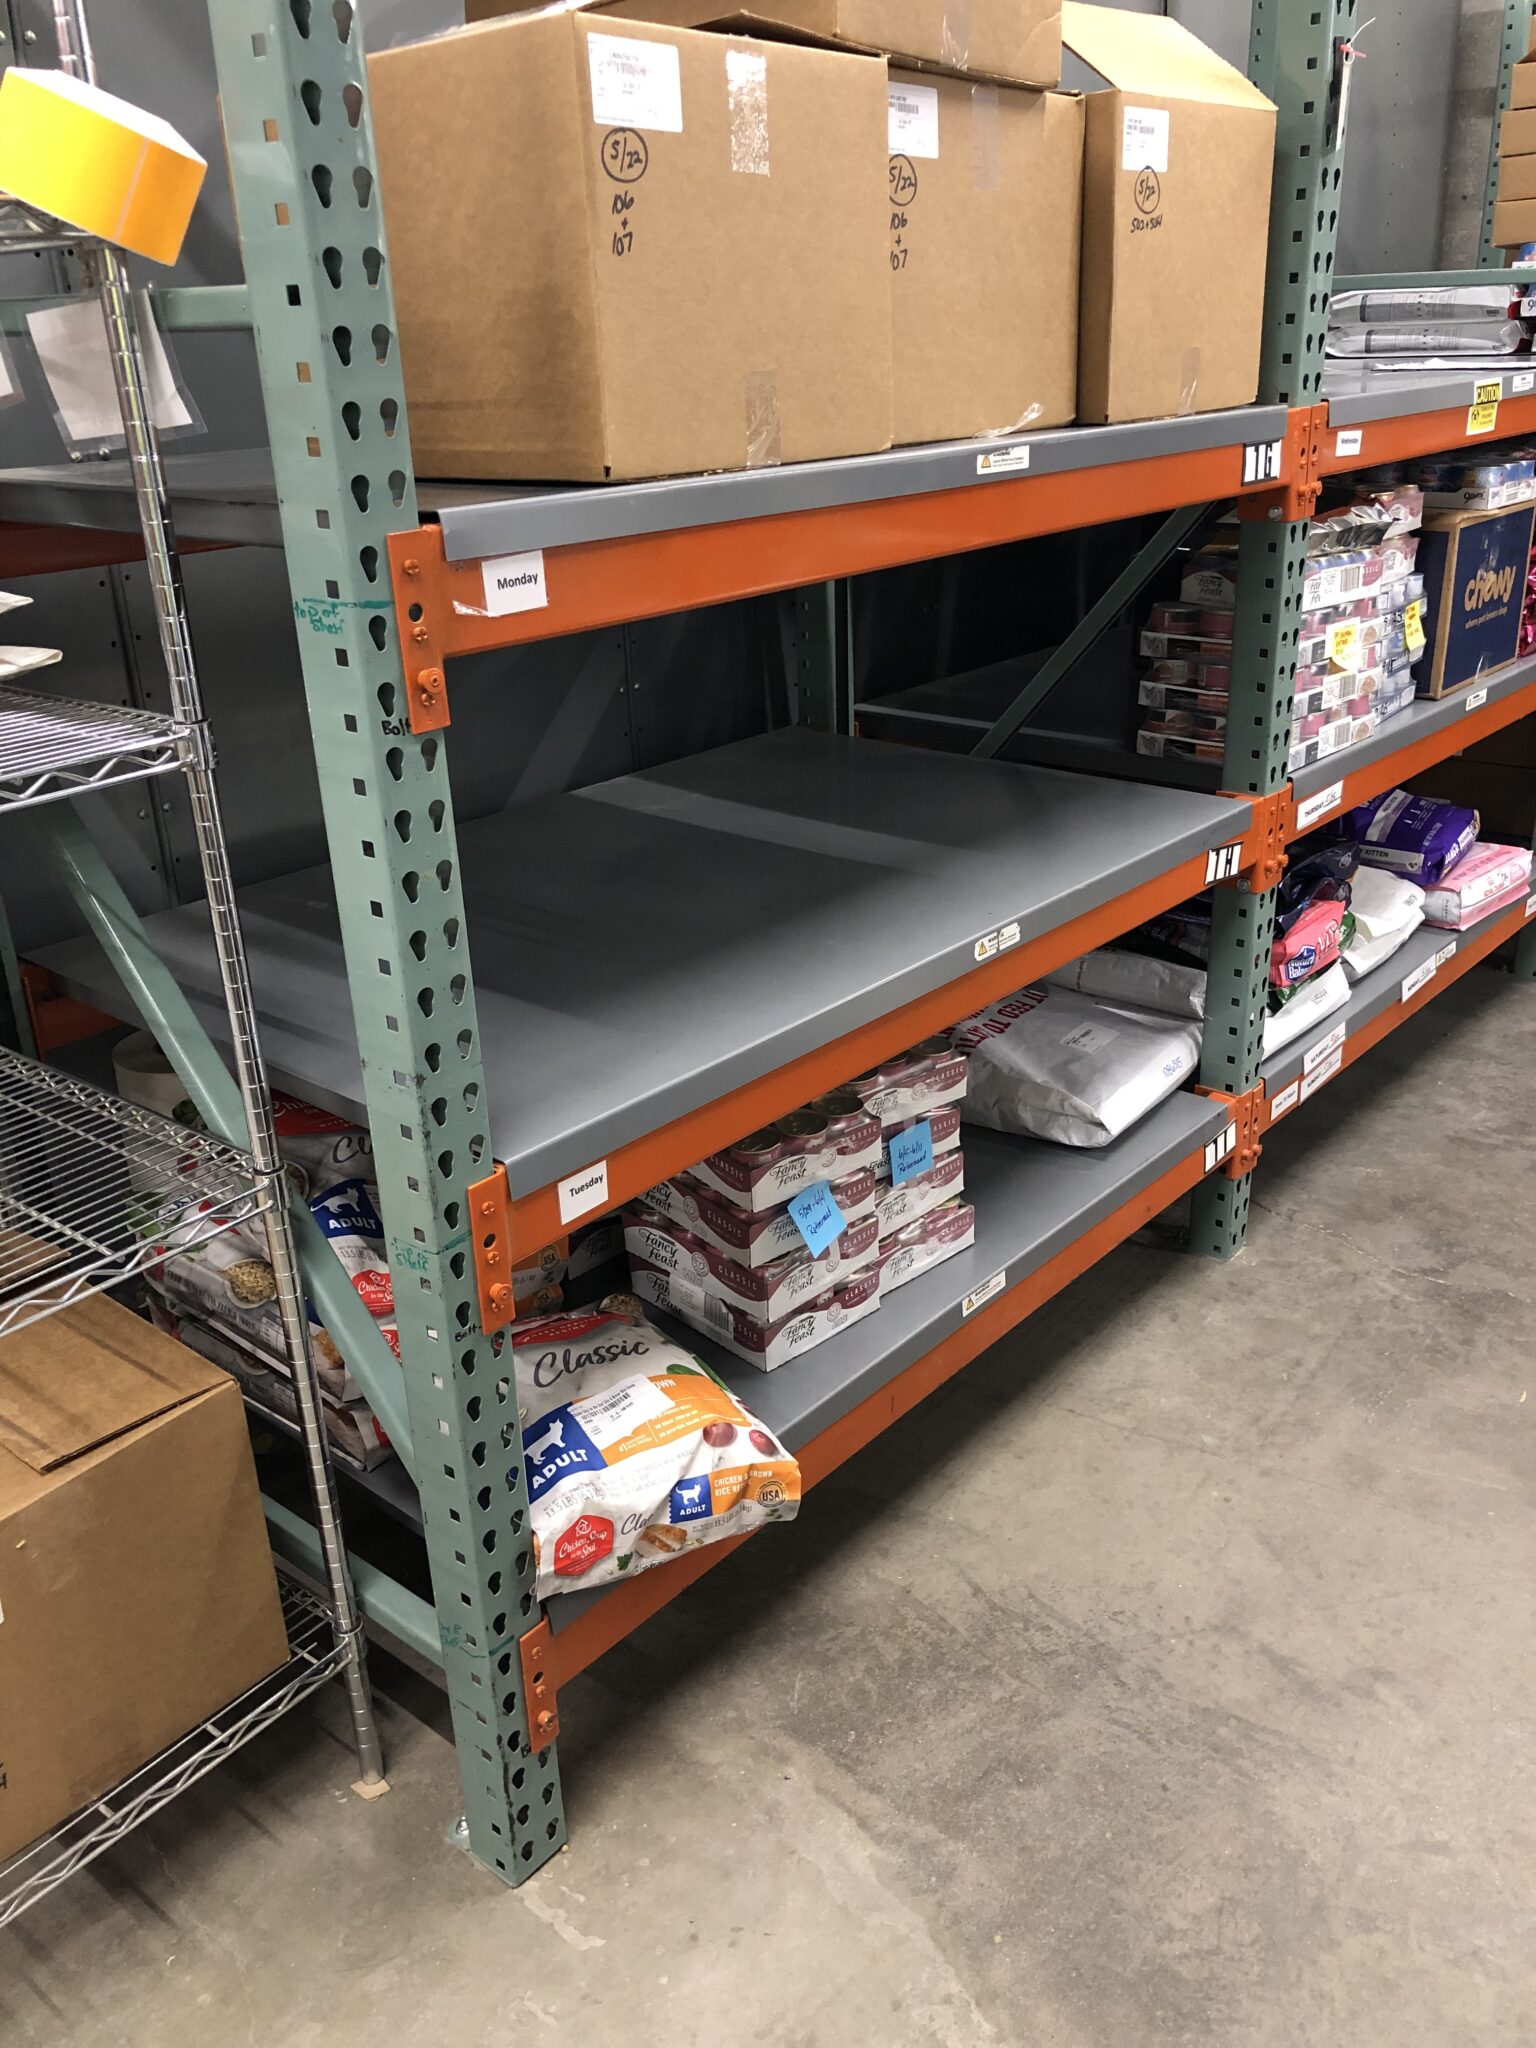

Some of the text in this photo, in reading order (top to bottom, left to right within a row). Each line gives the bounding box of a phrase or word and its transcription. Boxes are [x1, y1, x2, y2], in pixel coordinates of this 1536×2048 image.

[610, 136, 643, 173] 5/22
[612, 190, 634, 214] 106
[890, 212, 908, 231] 106
[612, 232, 633, 256] 107
[497, 572, 539, 590] Monday
[1465, 565, 1516, 611] chewy
[1364, 850, 1389, 858] KITTEN
[933, 1118, 956, 1131] ASSIC
[769, 1157, 808, 1179] Fancy
[775, 1168, 807, 1189] Feast
[569, 1173, 604, 1197] Tuesday
[842, 1179, 872, 1198] LASSIC
[329, 1216, 377, 1230] ADULT
[707, 1210, 742, 1238] CLASSIC
[638, 1228, 679, 1258] Fancy
[843, 1226, 875, 1250] CLASSIC
[646, 1244, 680, 1271] Feast
[718, 1264, 757, 1291] CLASSIC
[782, 1264, 814, 1288] Fancy
[787, 1275, 814, 1300] Feast
[845, 1277, 876, 1300] CLASSIC
[781, 1316, 816, 1339] Fancy
[787, 1326, 815, 1349] Feast
[533, 1340, 650, 1388] Classic
[531, 1449, 588, 1489] ADULT
[714, 1474, 743, 1487] CHICKEN
[714, 1487, 731, 1497] RICE
[762, 1490, 780, 1501] USA
[679, 1504, 706, 1516] ADULT
[559, 1530, 607, 1558] Chicken Soup
[581, 1543, 597, 1559] Soul
